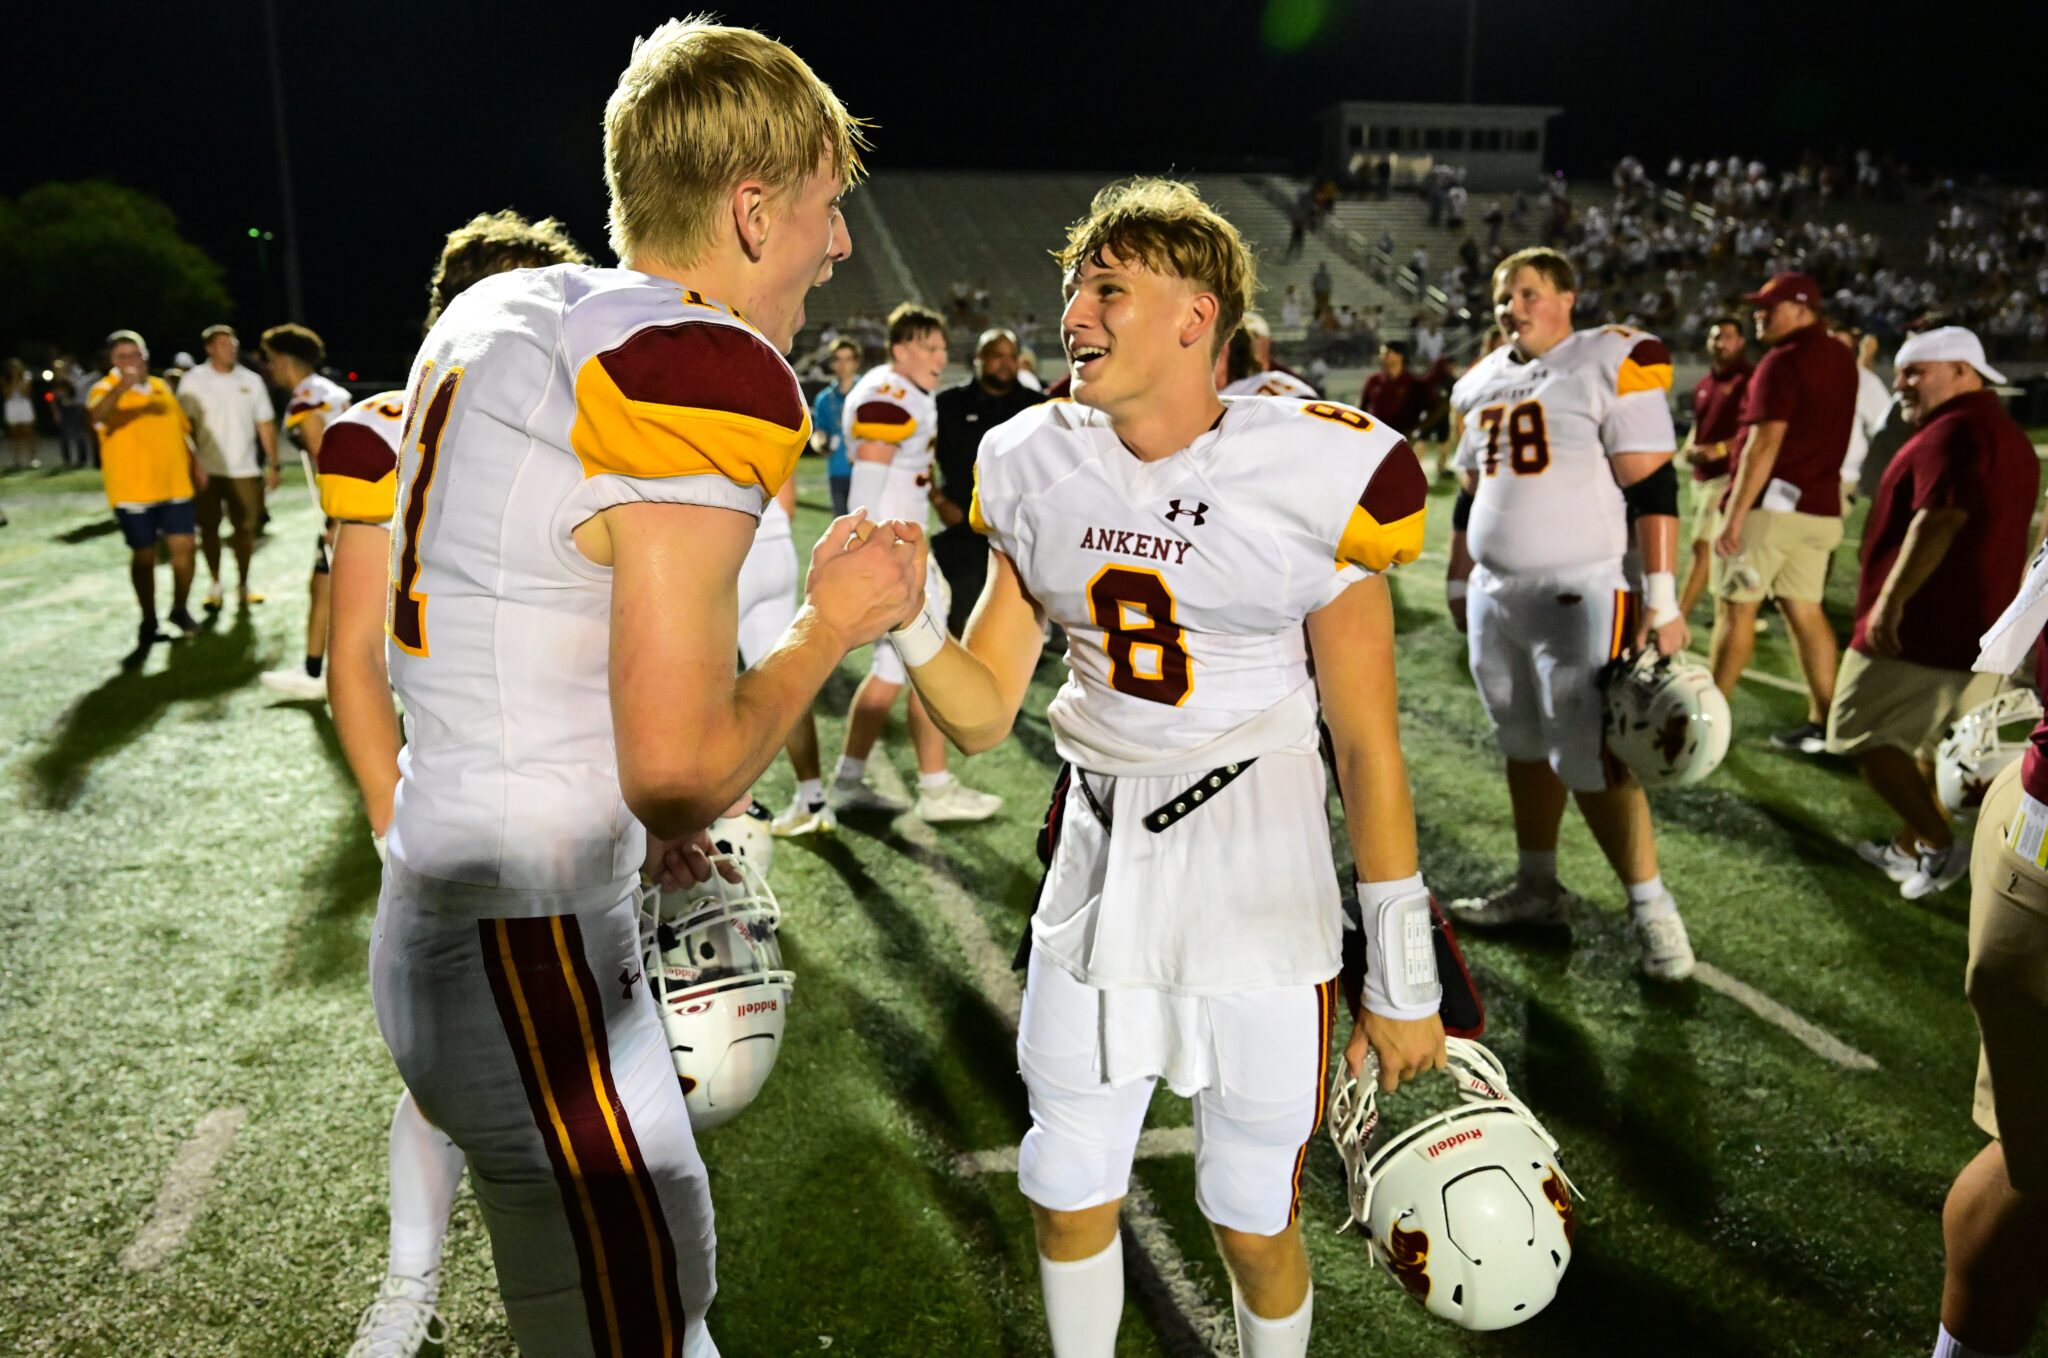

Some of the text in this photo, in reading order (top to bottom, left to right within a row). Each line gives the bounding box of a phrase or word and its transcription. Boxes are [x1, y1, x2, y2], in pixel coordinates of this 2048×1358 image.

[1300, 402, 1374, 432] 8
[1479, 398, 1552, 478] 78
[1080, 526, 1192, 565] ANKENY
[1086, 562, 1194, 708] 8
[737, 999, 777, 1018] Riddell
[1427, 1128, 1483, 1158] Riddell
